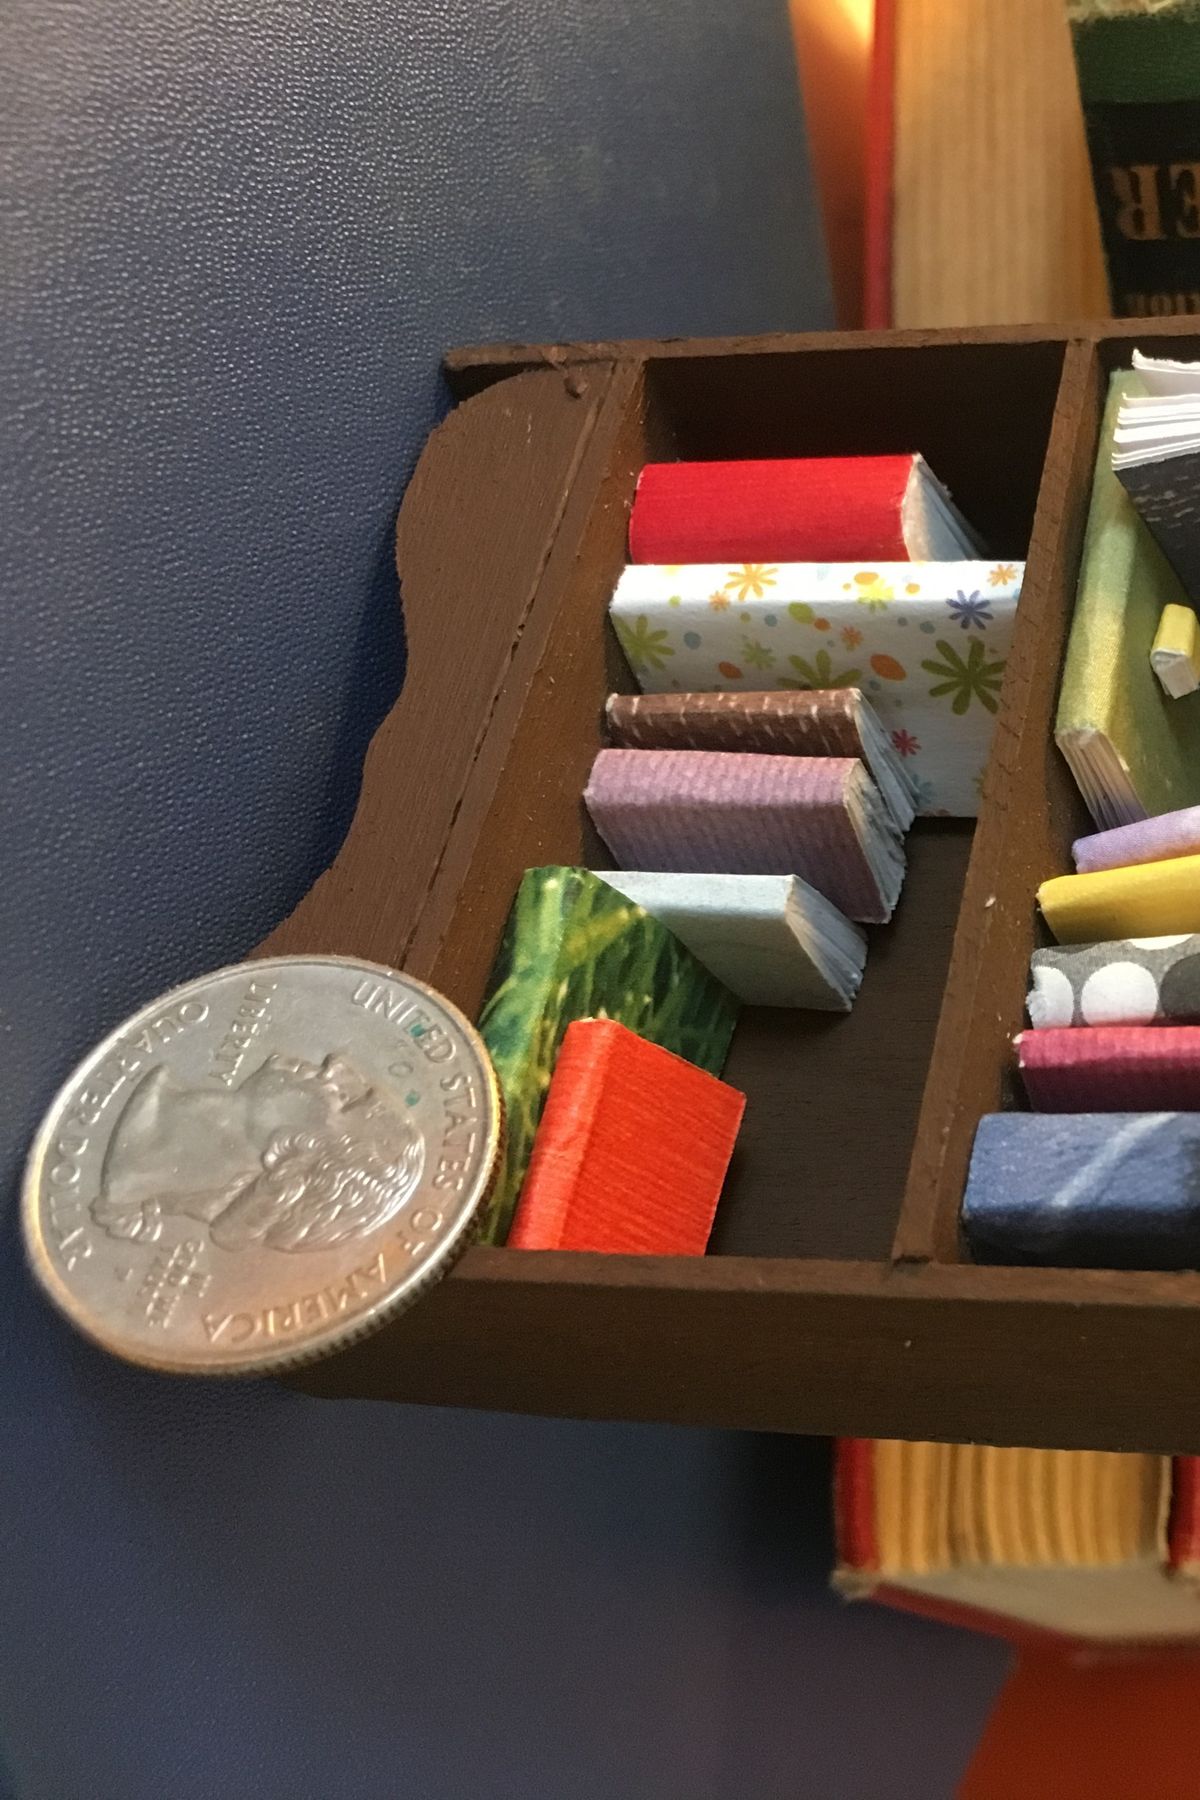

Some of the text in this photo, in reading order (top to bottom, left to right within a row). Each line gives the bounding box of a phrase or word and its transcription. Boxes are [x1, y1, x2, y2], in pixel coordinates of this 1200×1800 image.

[50, 1001, 210, 1273] QUARTER DOLLAR
[201, 978, 478, 1344] UNITED STATES OF AMERICA
[210, 978, 278, 1088] LIBERTY
